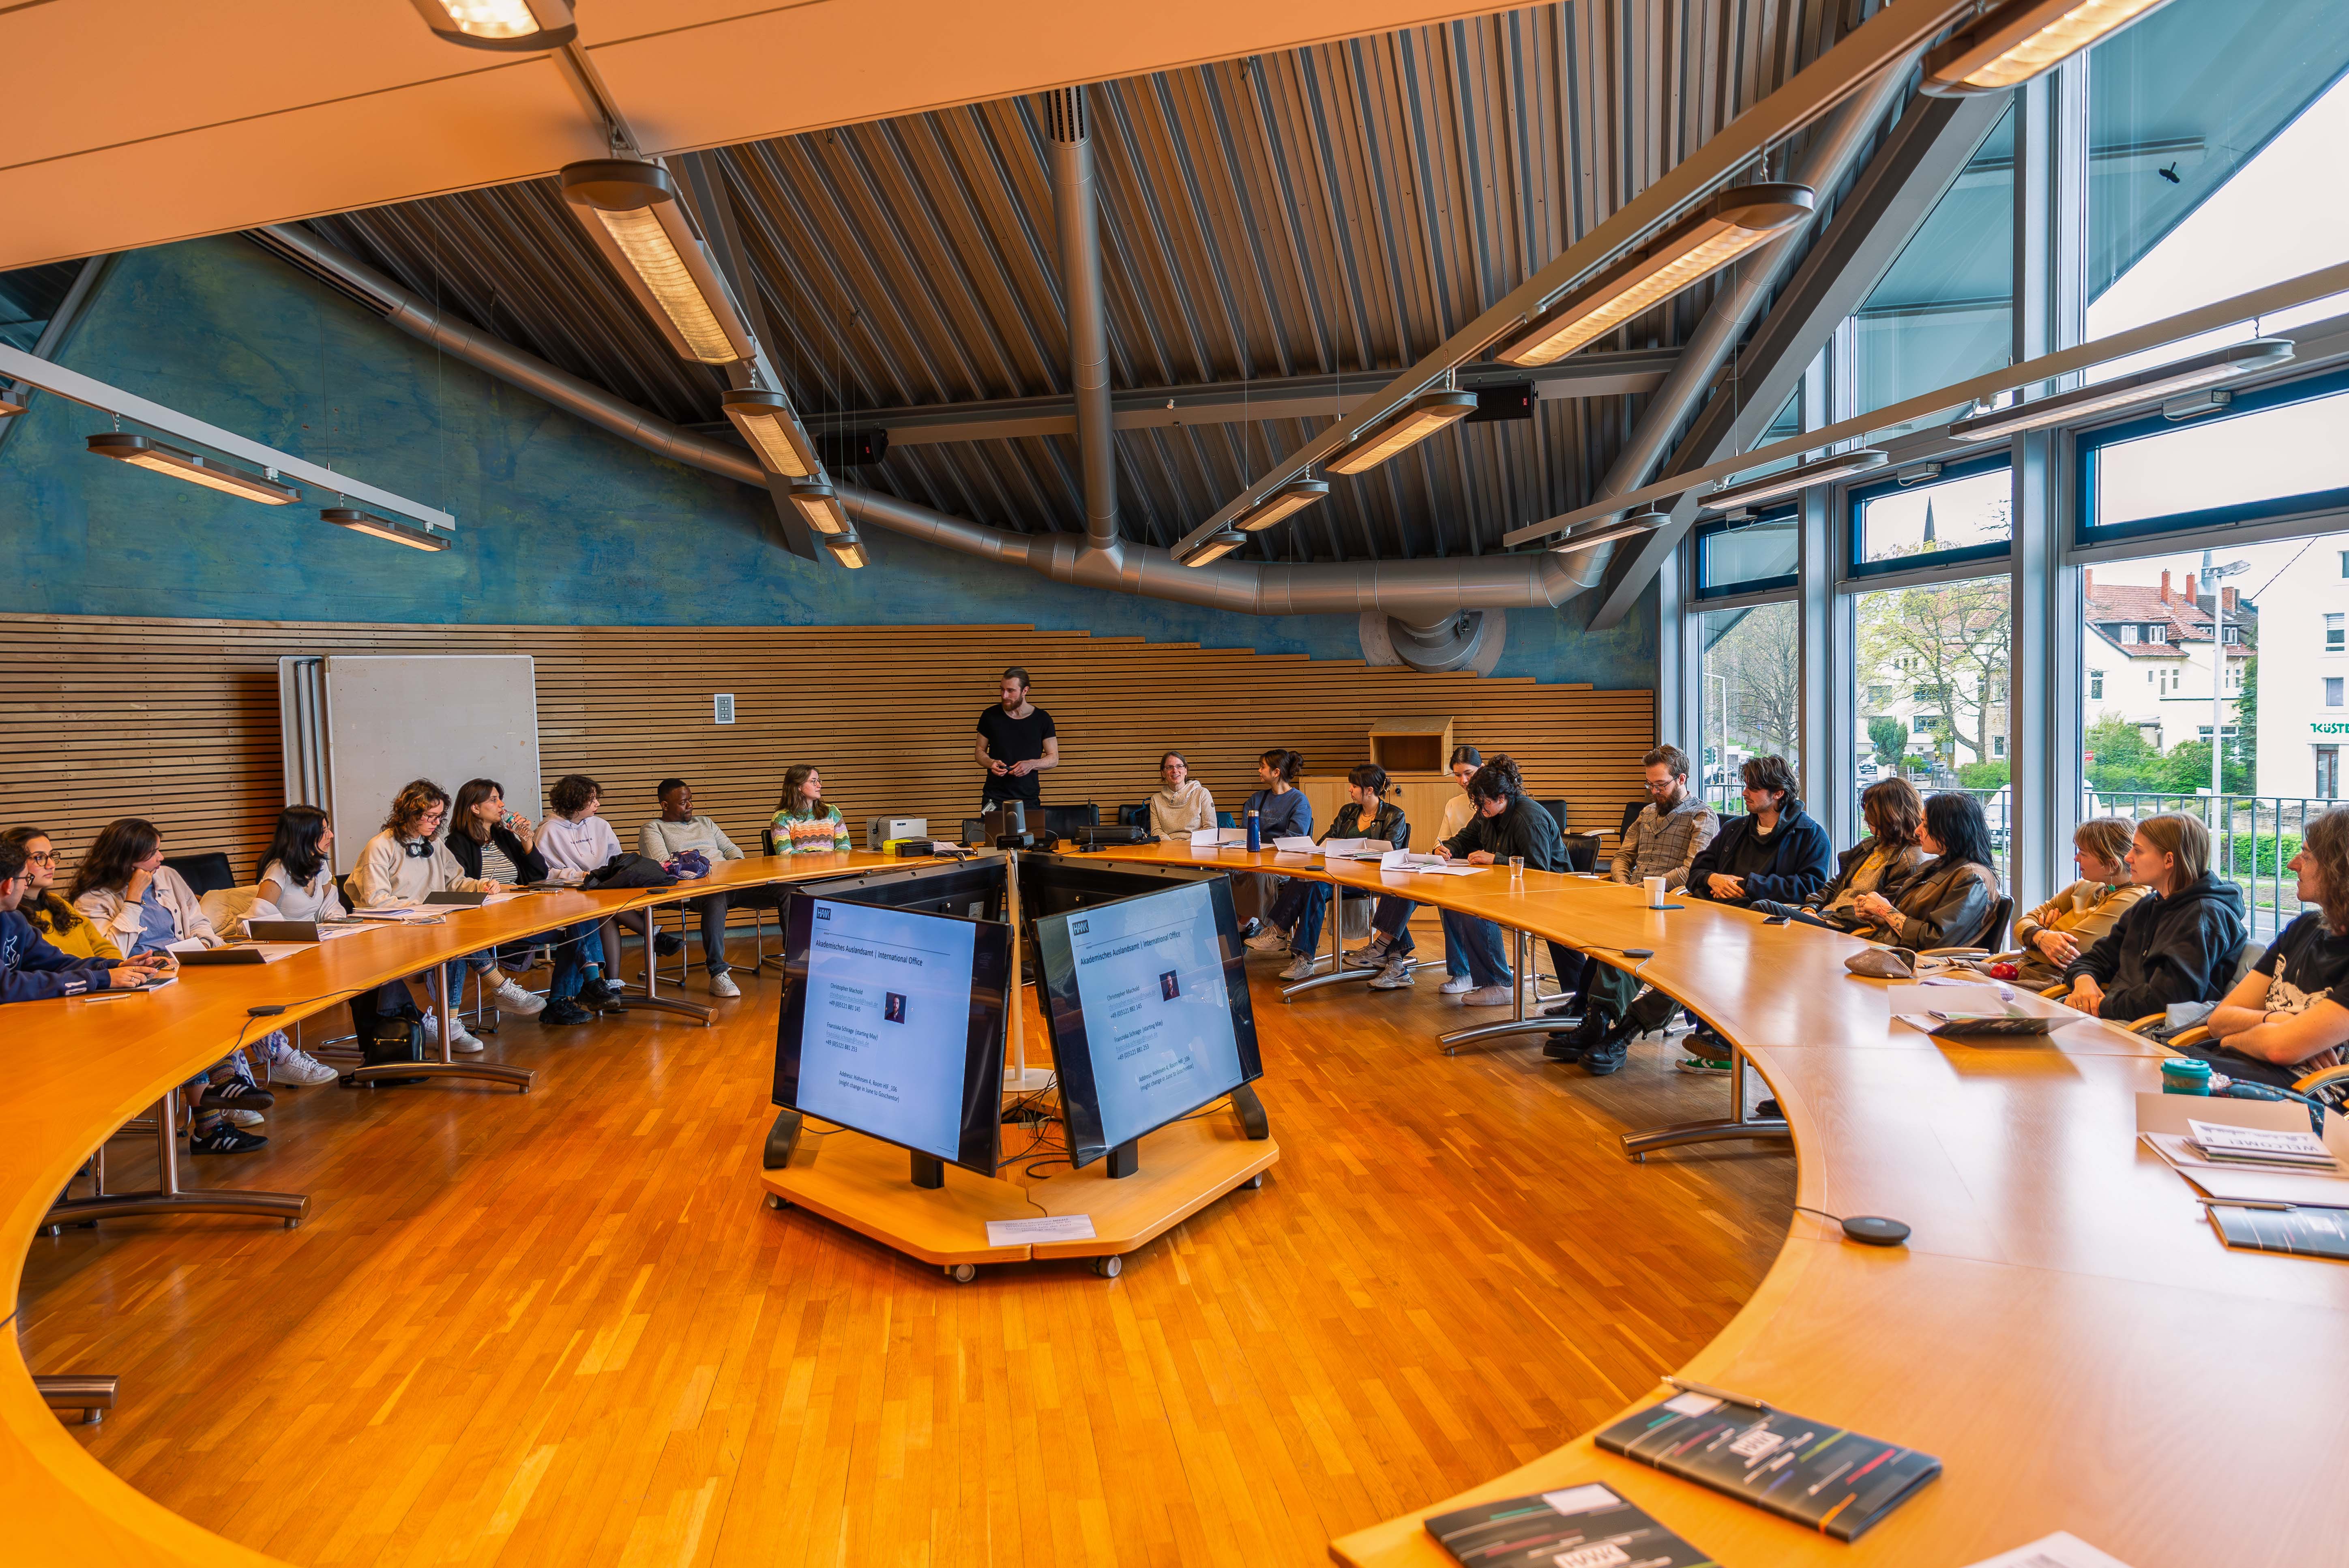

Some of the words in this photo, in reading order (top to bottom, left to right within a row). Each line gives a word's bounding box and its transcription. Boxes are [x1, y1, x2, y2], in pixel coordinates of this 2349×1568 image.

[817, 908, 830, 919] HAWK
[1074, 921, 1088, 934] HAWK
[816, 940, 845, 951] Akademisches
[845, 946, 873, 957] Auslandsamt
[878, 951, 907, 963] International
[909, 957, 923, 966] Office
[1081, 951, 1112, 965] Akademisches
[1113, 943, 1140, 956] Auslandsamt
[1143, 934, 1169, 947] International
[1169, 931, 1181, 940] Office
[830, 983, 849, 991] Christopher
[1107, 991, 1126, 1001] Christopher
[1126, 985, 1140, 995] Machold
[1117, 1008, 1129, 1018] (0)5121
[827, 1022, 841, 1030] Franziska
[842, 1026, 854, 1034] Schrage
[855, 1029, 869, 1038] (starting
[869, 1033, 878, 1041] May)
[1114, 1034, 1129, 1043] Franziska
[1129, 1029, 1141, 1037] Schrage
[1142, 1024, 1155, 1033] (starting
[1124, 1049, 1136, 1060] (0)5121
[839, 1070, 853, 1079] Address:
[854, 1075, 868, 1083] Hohnsen
[1139, 1073, 1152, 1082] Address:
[1152, 1067, 1166, 1076] Hohnsen
[839, 1079, 849, 1087] (might
[850, 1083, 861, 1091] change
[1140, 1083, 1151, 1092] (might
[1151, 1078, 1162, 1087] change
[2230, 1138, 2319, 1152] WELCOME!
